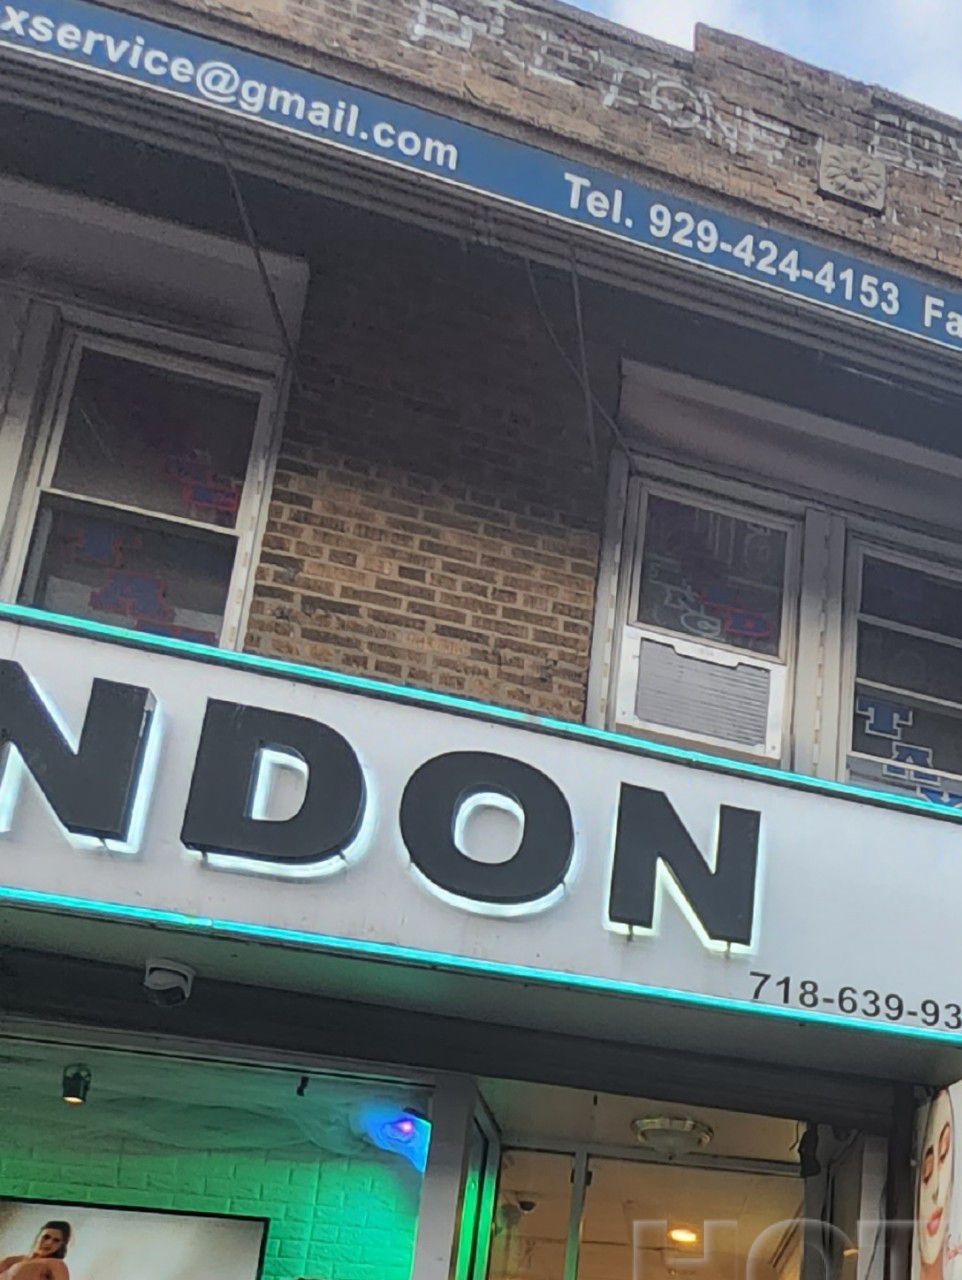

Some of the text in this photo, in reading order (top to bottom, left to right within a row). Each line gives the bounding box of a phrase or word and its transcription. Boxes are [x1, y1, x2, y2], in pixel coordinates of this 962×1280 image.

[0, 5, 458, 170] xservice@gmail.com
[563, 172, 633, 229] Tel.
[649, 203, 900, 316] 929-424-4153
[0, 658, 762, 950] NDON
